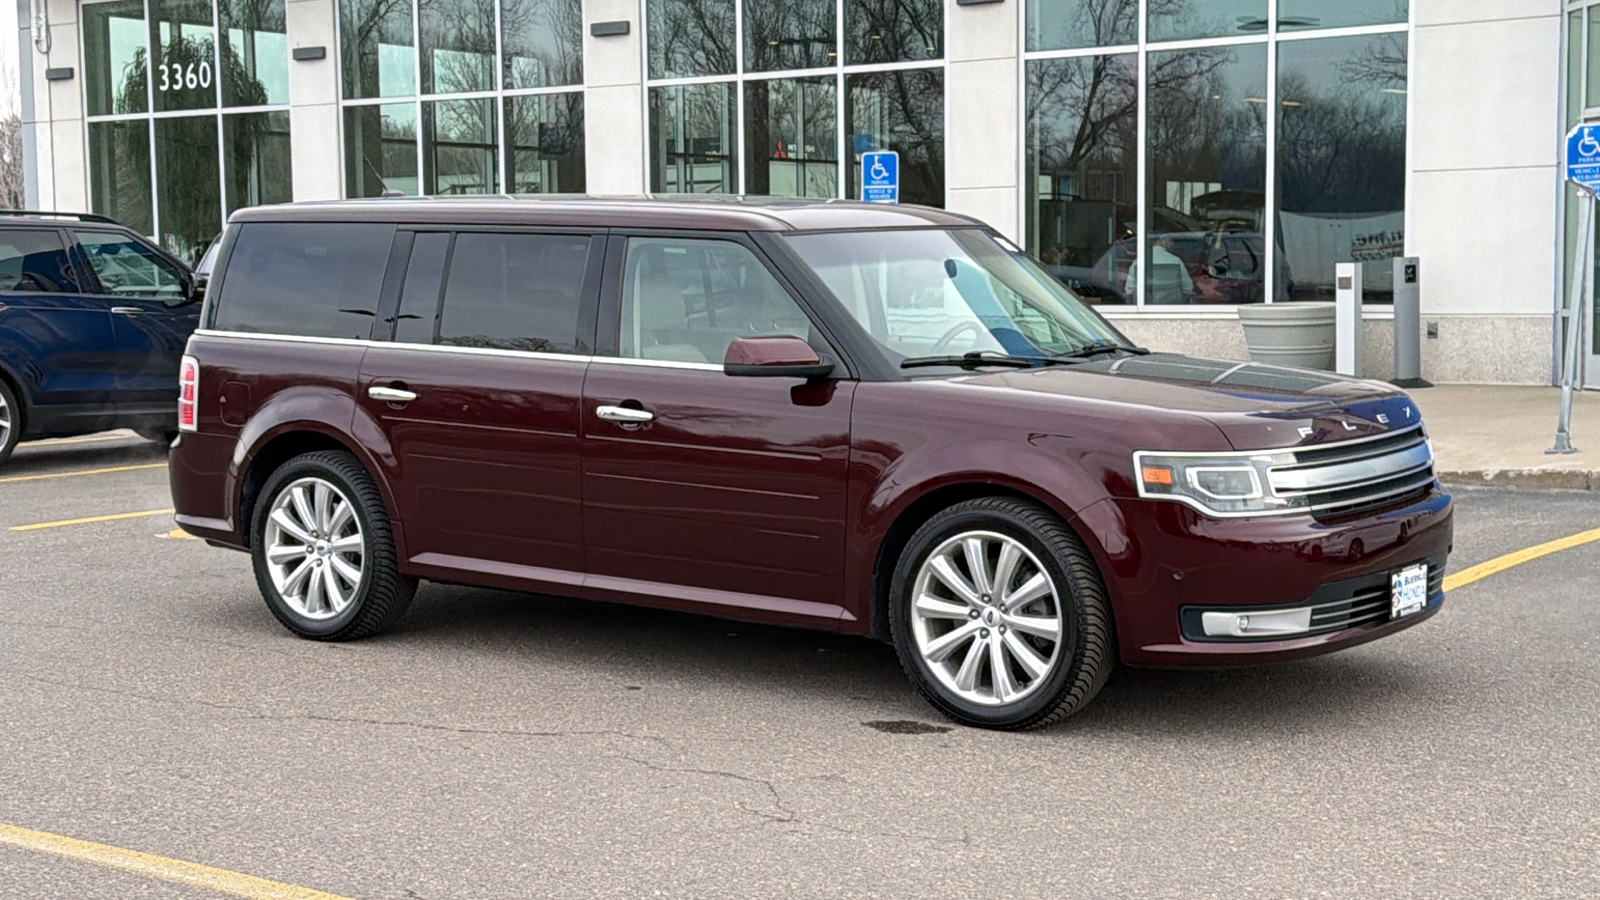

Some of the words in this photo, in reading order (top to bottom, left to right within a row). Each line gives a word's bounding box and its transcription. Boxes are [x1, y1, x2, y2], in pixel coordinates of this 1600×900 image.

[158, 62, 211, 91] 3360
[1296, 406, 1414, 439] FLEX
[1402, 585, 1427, 602] HONDA
